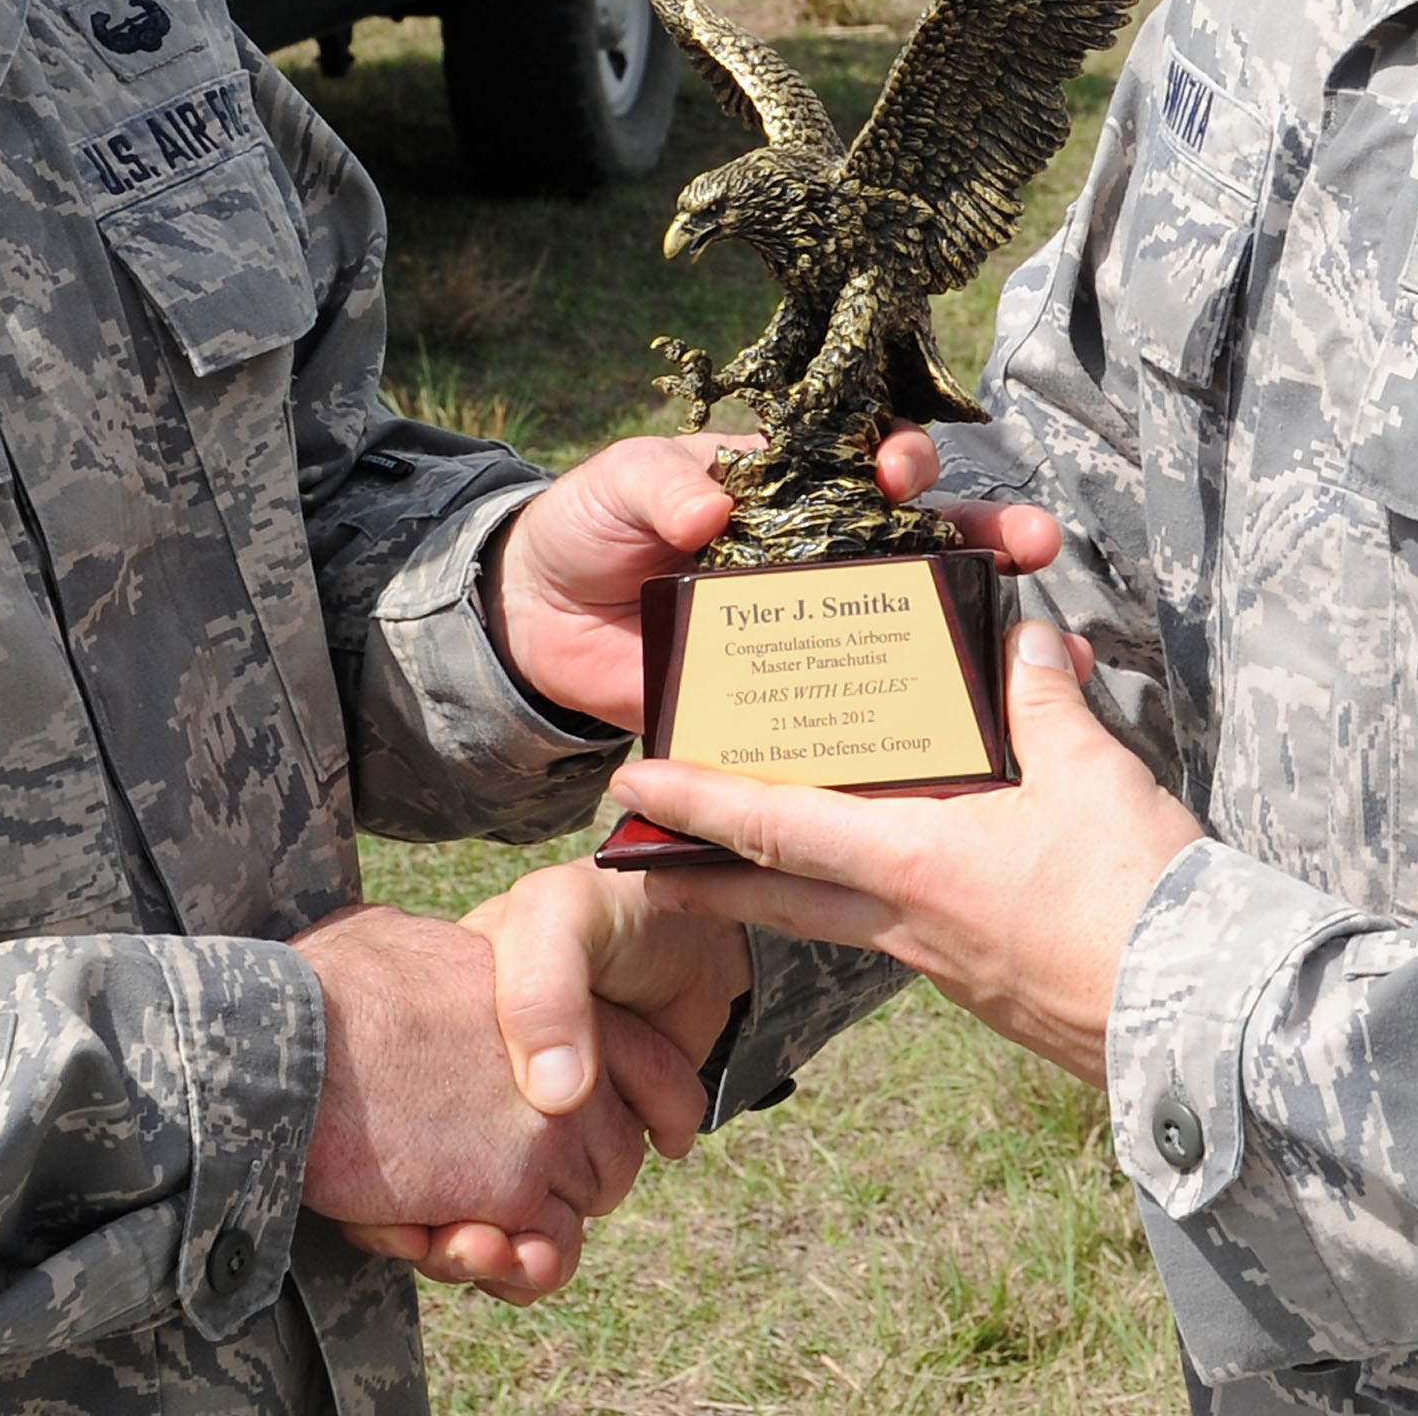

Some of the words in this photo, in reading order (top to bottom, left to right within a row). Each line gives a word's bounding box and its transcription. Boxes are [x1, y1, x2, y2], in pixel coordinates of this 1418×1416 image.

[83, 134, 161, 195] U.S.
[146, 102, 219, 170] AIR
[719, 603, 785, 631] Tyler
[792, 599, 814, 621] J.
[822, 592, 911, 618] Smitka
[724, 636, 842, 657] Congratulations
[845, 629, 911, 647] Airborne
[751, 659, 803, 675] Master
[806, 651, 888, 670] Parachutist
[793, 682, 838, 700] WITH
[771, 717, 788, 731] 21
[792, 713, 837, 729] March
[841, 709, 876, 725] 2012
[720, 748, 765, 766] 820th
[769, 745, 808, 762] Base
[812, 741, 877, 758] Defense
[880, 736, 932, 753] Group
